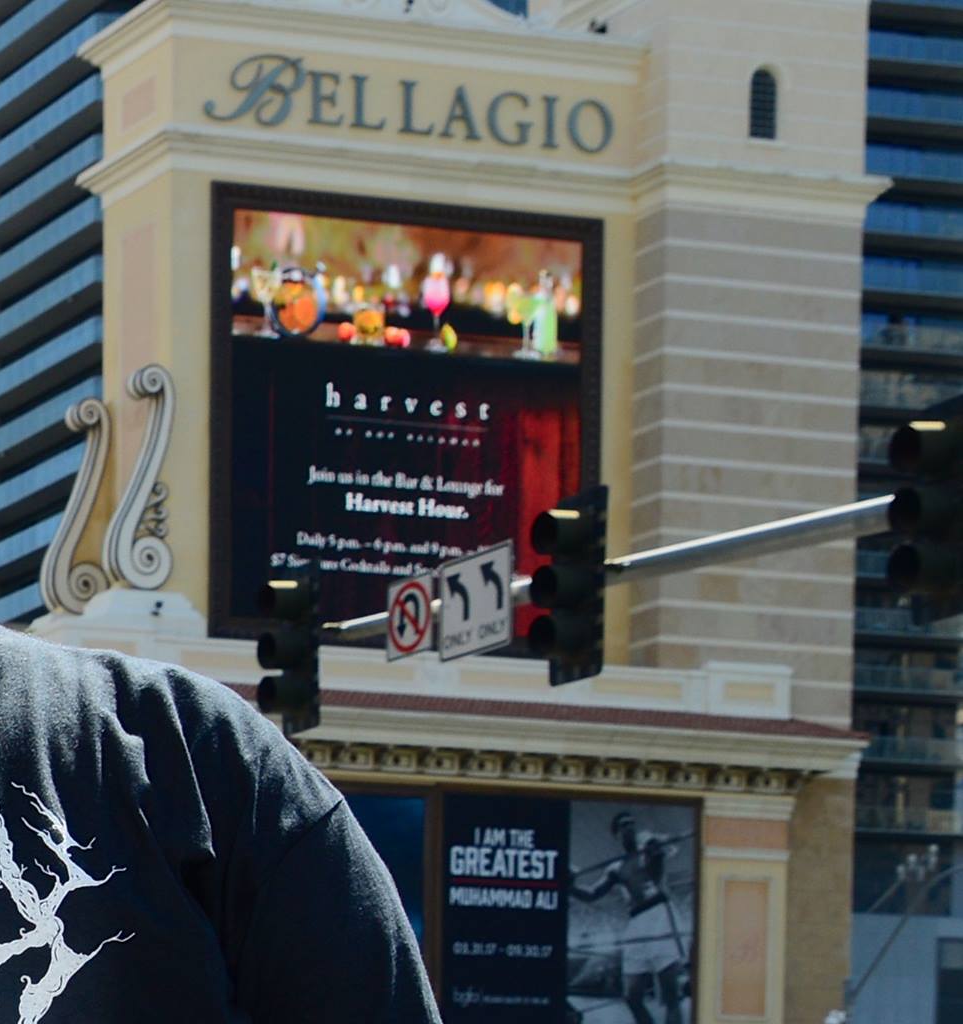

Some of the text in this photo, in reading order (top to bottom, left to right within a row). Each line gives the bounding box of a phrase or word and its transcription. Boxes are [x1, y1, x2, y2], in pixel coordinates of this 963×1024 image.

[203, 53, 614, 154] BELLAGIO
[325, 382, 490, 421] harvest
[306, 465, 504, 499] Join us in the Bar & Lounge for
[345, 492, 469, 519] Harvest Hour.
[296, 531, 325, 549] Daily
[410, 541, 430, 554] and
[339, 557, 391, 574] Cocktails
[392, 562, 413, 576] and
[444, 617, 506, 650] ONLY ONLY
[474, 827, 535, 849] I AM THE
[449, 846, 558, 879] GREATEST
[448, 886, 558, 910] MUHAMMAD ALI
